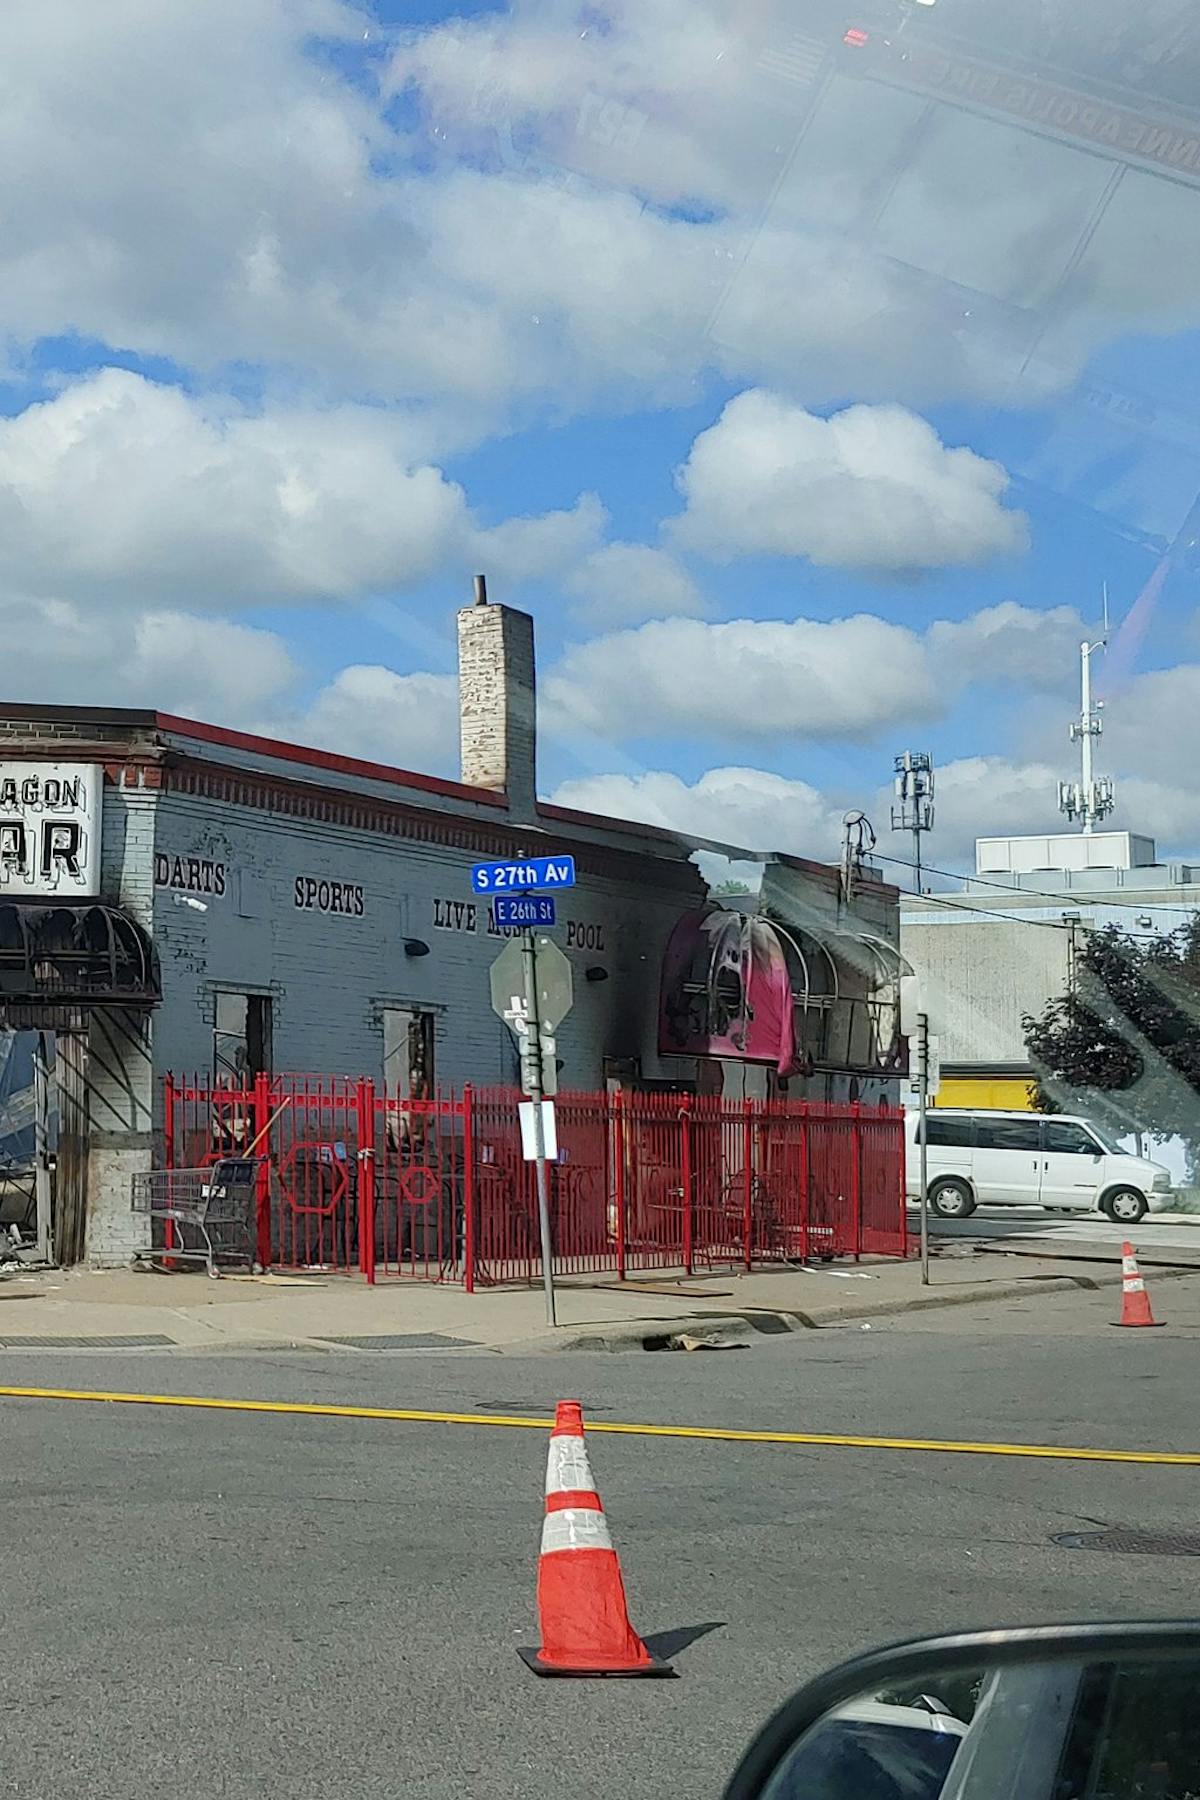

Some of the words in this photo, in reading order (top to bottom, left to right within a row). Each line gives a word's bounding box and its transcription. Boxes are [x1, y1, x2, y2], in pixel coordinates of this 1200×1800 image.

[154, 853, 226, 897] DARTS
[477, 870, 489, 888] S
[495, 866, 537, 886] 27th
[545, 863, 569, 882] Av
[295, 876, 364, 917] SPORTS
[498, 902, 506, 920] E
[510, 902, 537, 920] 26th
[540, 902, 552, 920] St
[434, 899, 476, 932] LIVE
[567, 920, 604, 951] POOL
